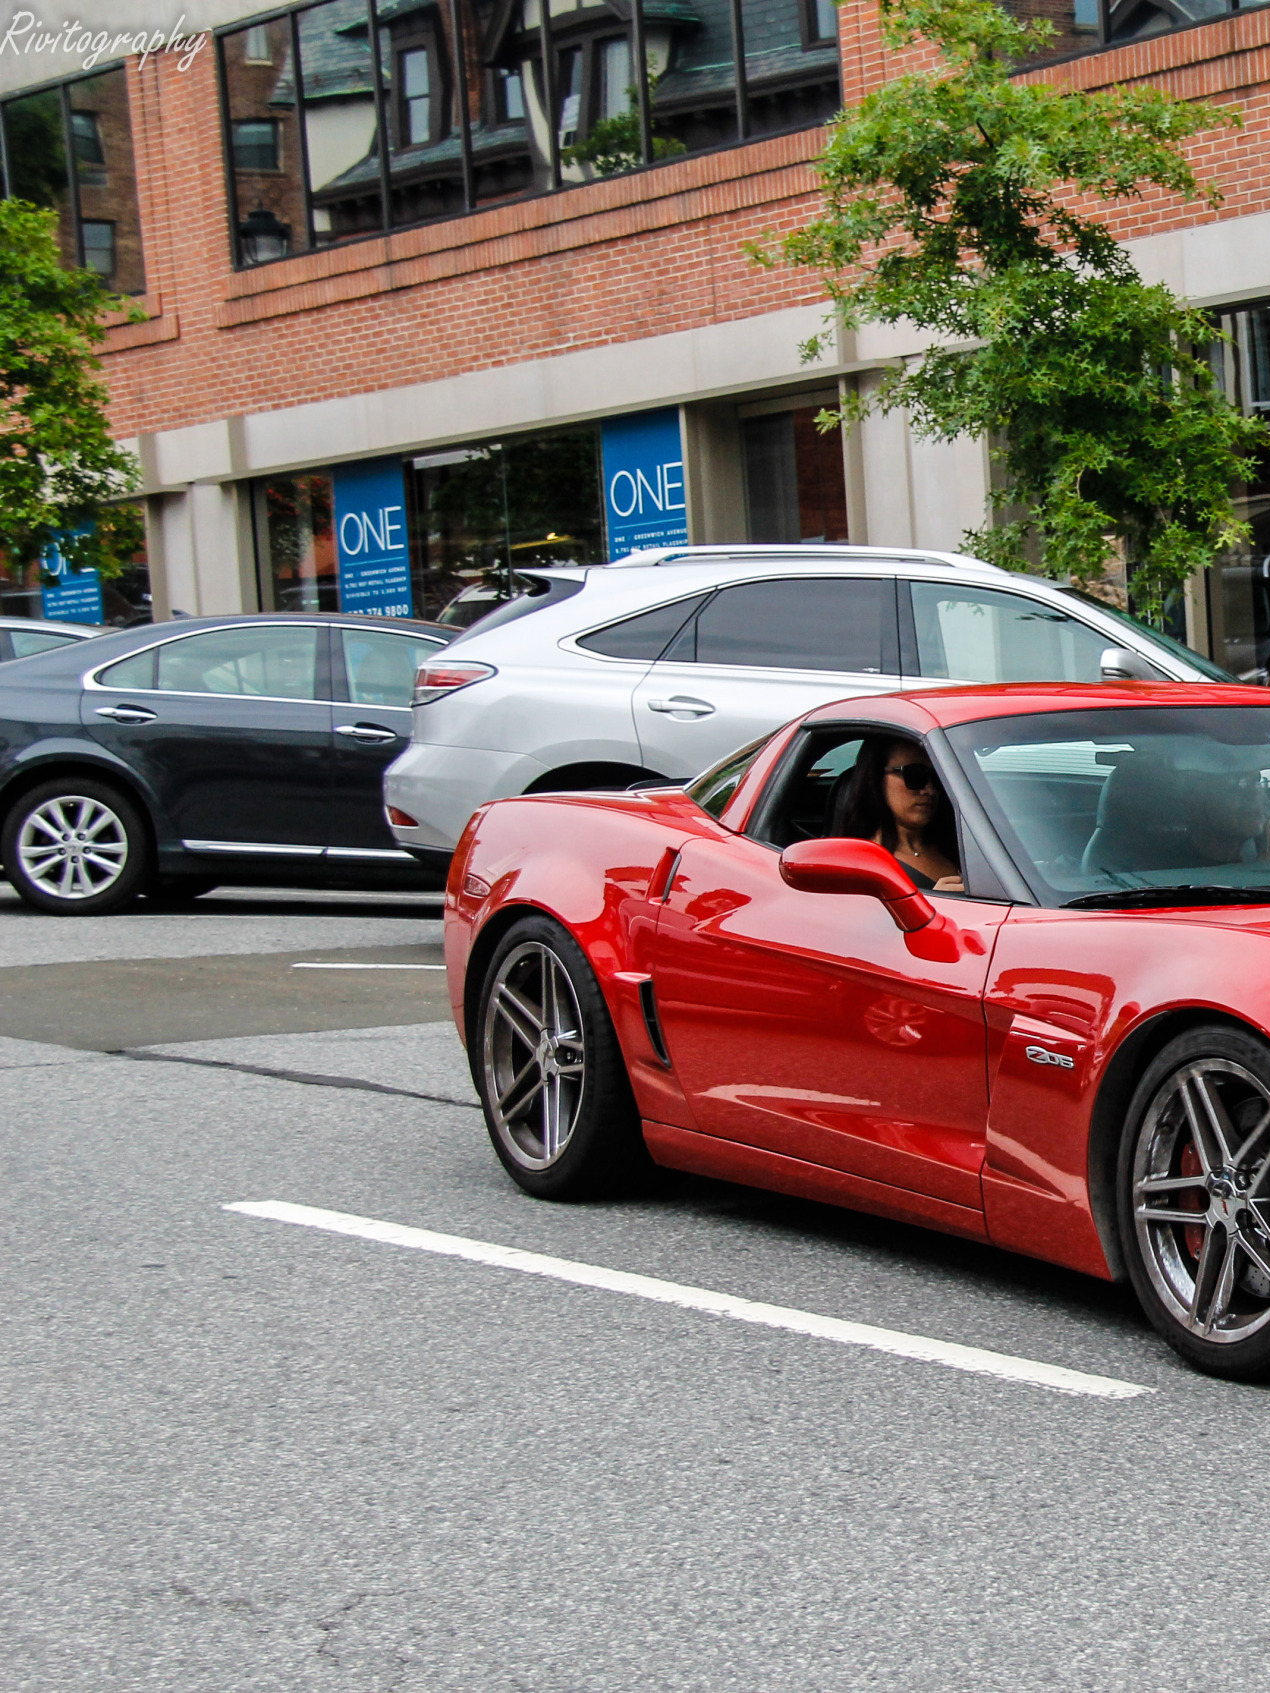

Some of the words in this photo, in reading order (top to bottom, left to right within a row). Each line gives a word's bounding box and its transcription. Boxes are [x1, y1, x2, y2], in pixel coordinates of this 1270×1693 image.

[610, 461, 686, 518] ONE
[340, 505, 405, 556] ONE
[1025, 1045, 1075, 1069] Z06
